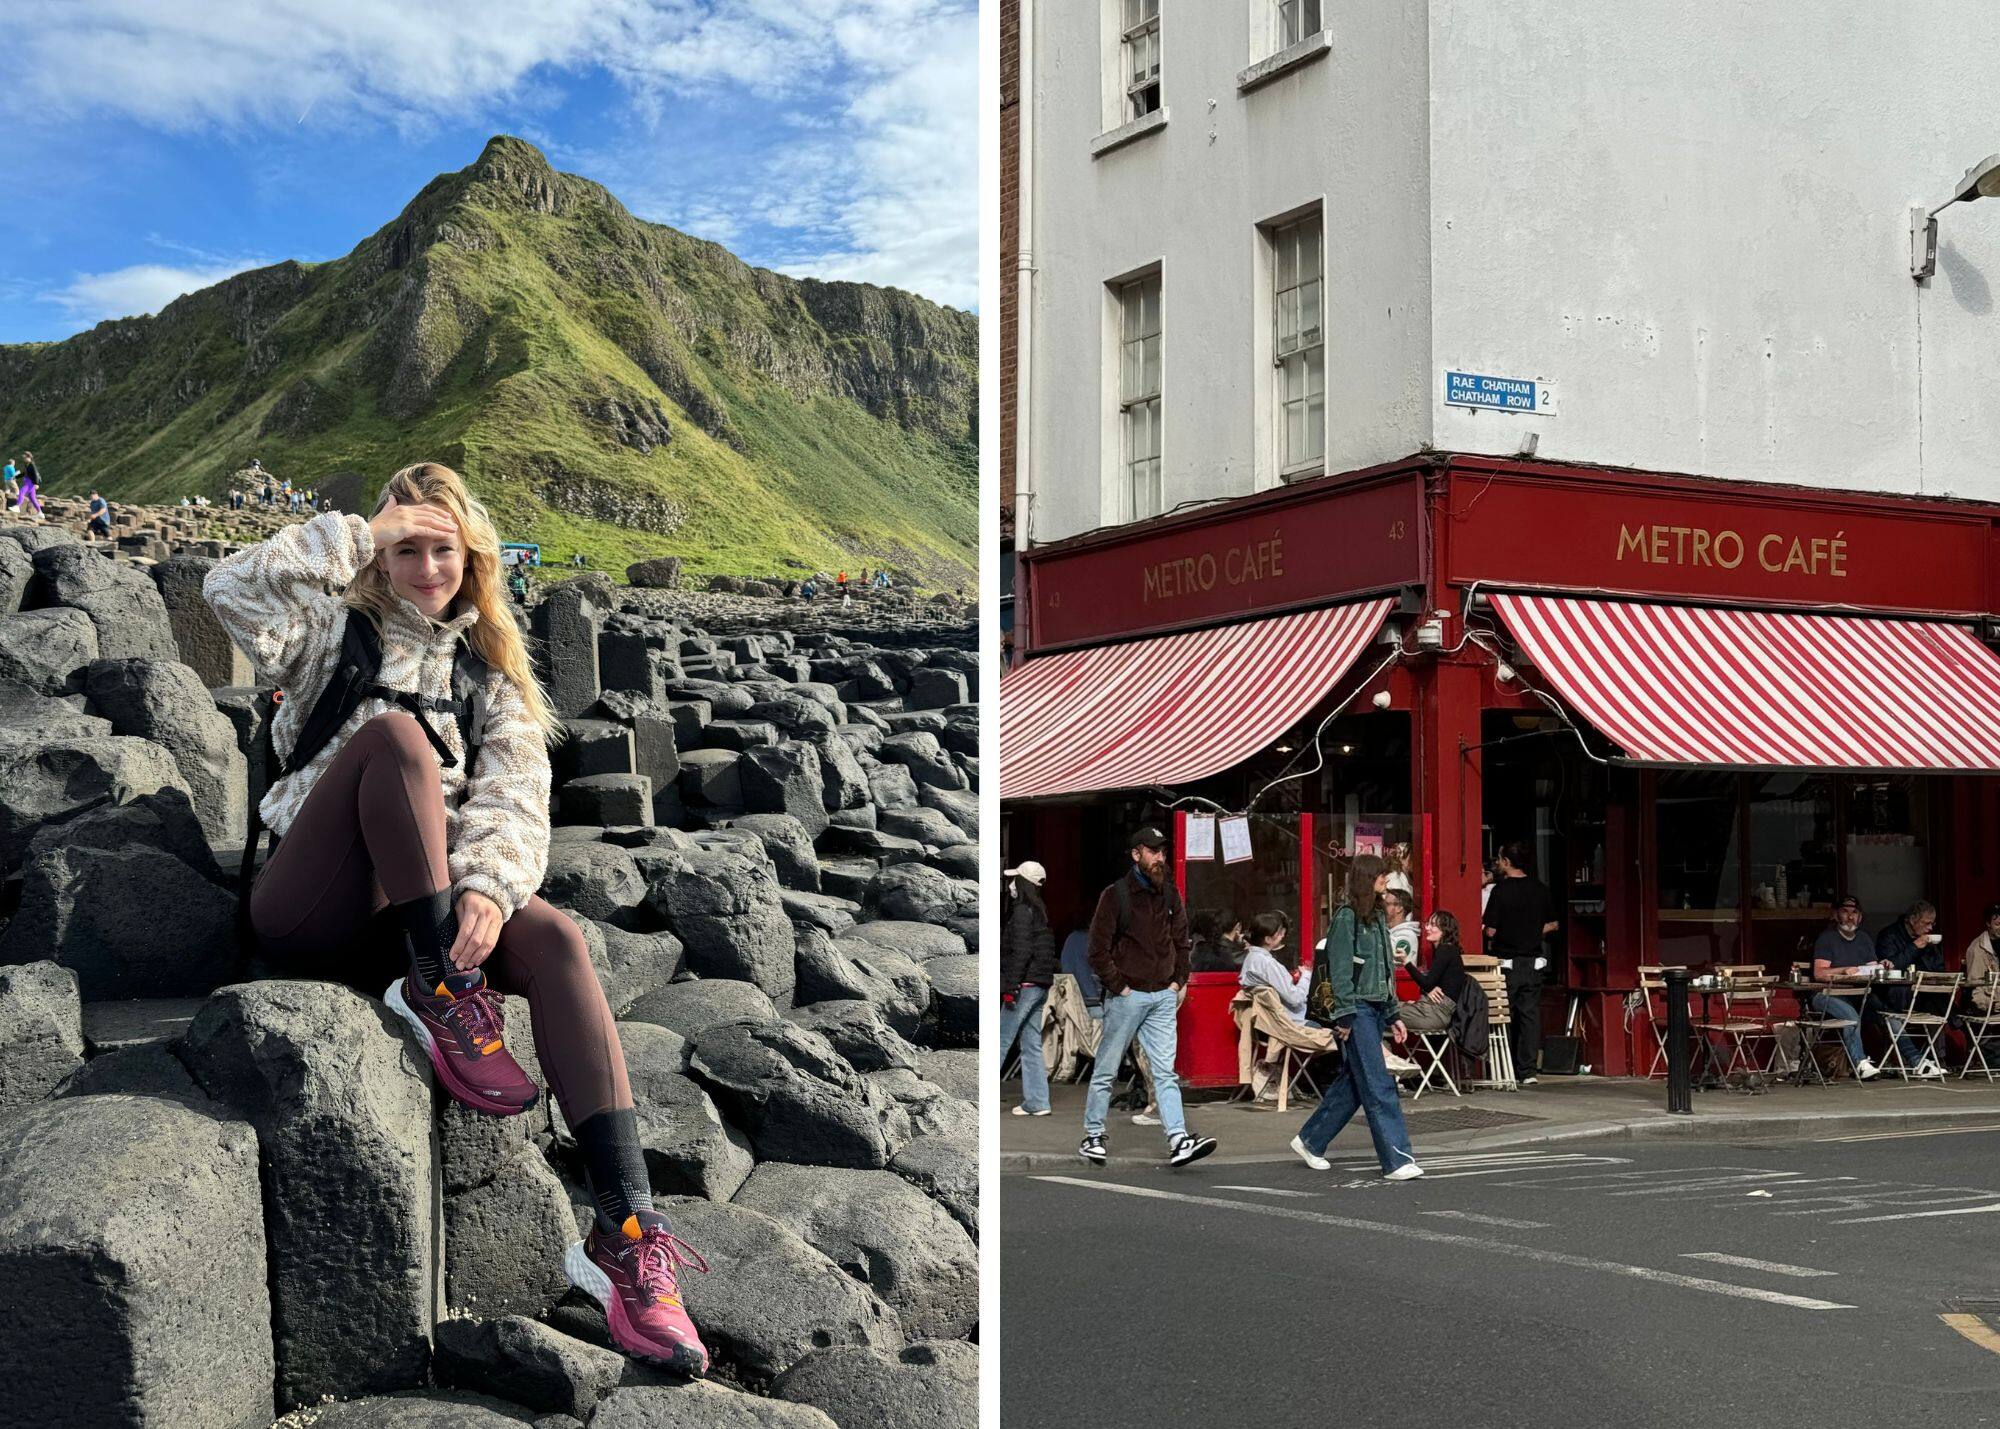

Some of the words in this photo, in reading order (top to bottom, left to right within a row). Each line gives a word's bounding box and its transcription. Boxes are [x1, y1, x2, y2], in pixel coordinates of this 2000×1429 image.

[1453, 376, 1475, 388] RAE
[1482, 380, 1530, 395] CHATHAM
[1451, 390, 1500, 405] CHATHAM
[1507, 396, 1531, 408] ROW
[1542, 390, 1550, 405] 2
[1388, 521, 1404, 540] 43
[1617, 524, 1744, 570] METRO
[1758, 530, 1848, 577] CAFÉ
[1143, 553, 1217, 602] METRO
[1224, 528, 1284, 587] CAFÉ
